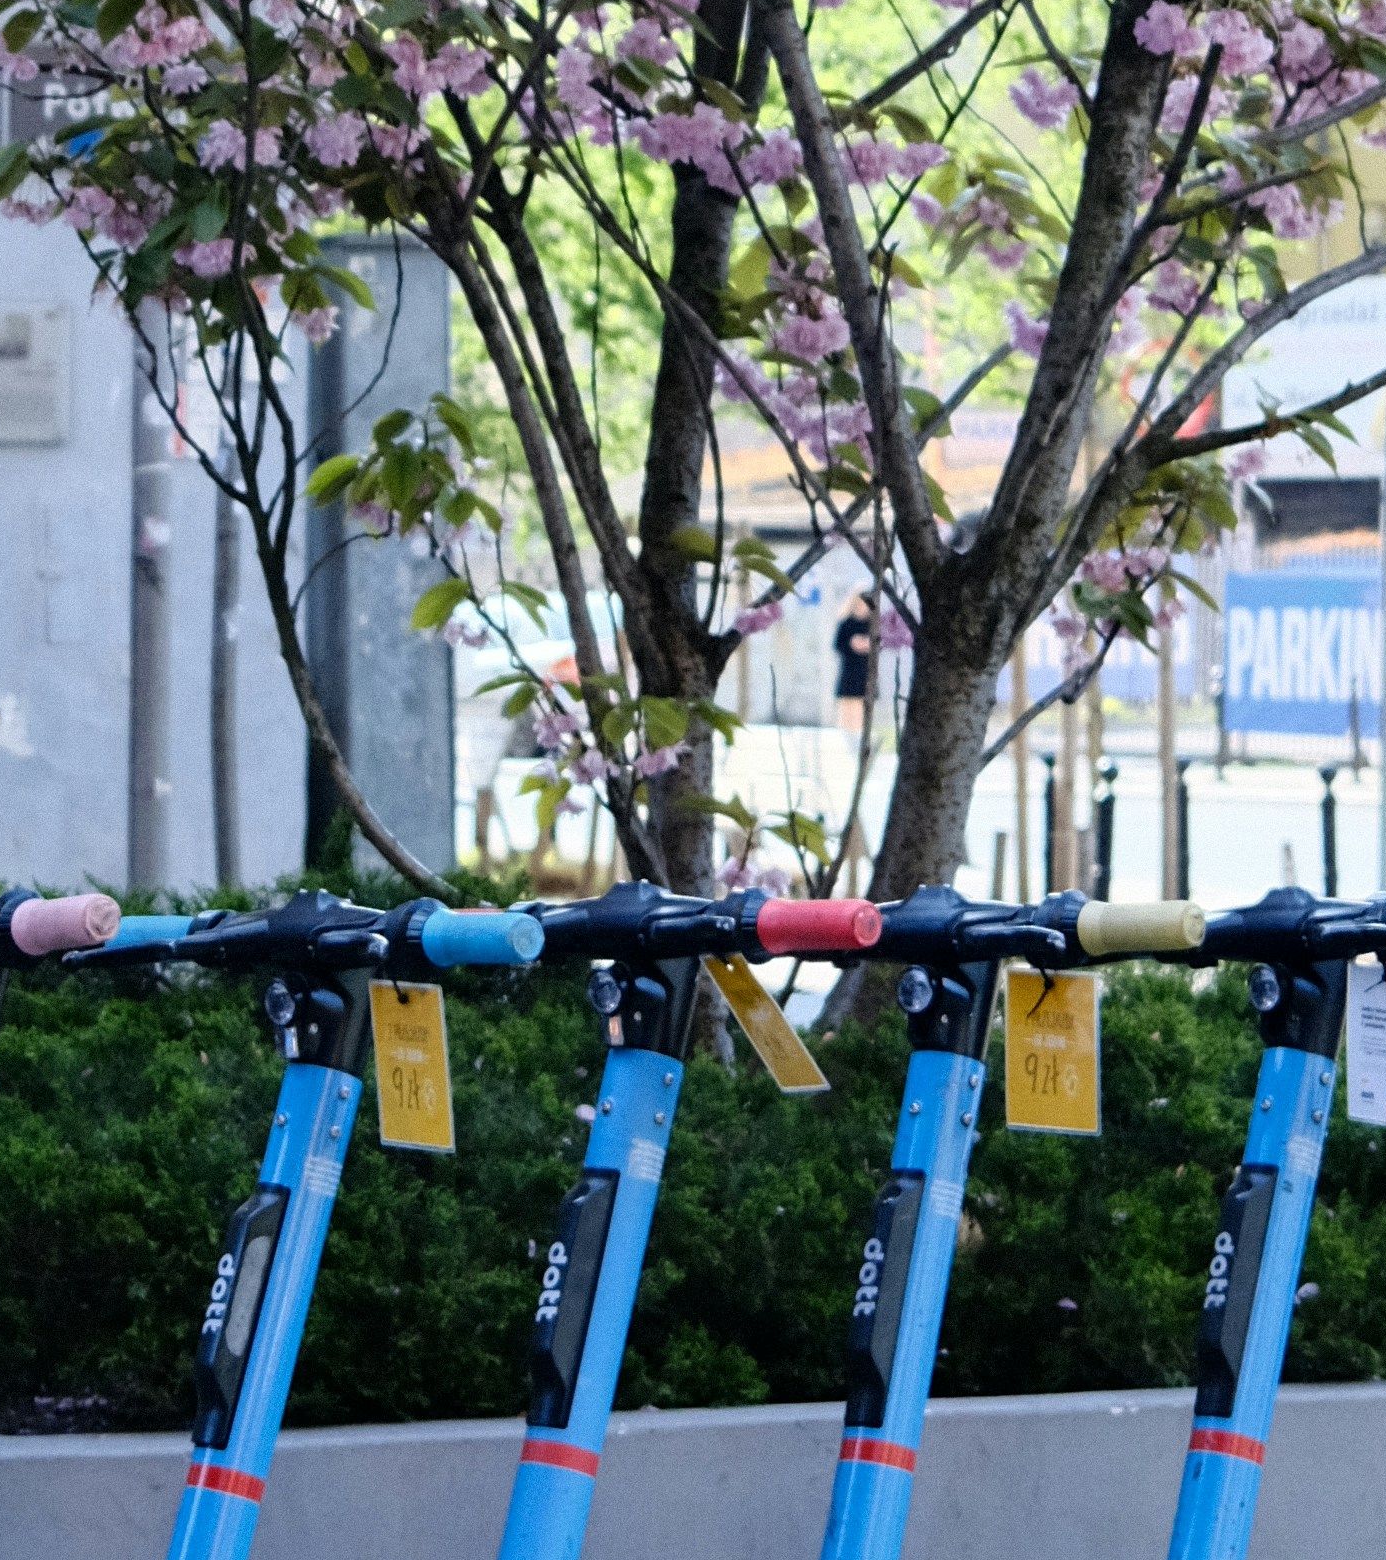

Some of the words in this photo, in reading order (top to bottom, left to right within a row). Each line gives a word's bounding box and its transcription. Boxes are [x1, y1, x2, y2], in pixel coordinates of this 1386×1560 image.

[201, 1252, 235, 1334] dott
[535, 1241, 568, 1322] dott
[853, 1238, 884, 1317] dott
[1203, 1231, 1234, 1309] dott
